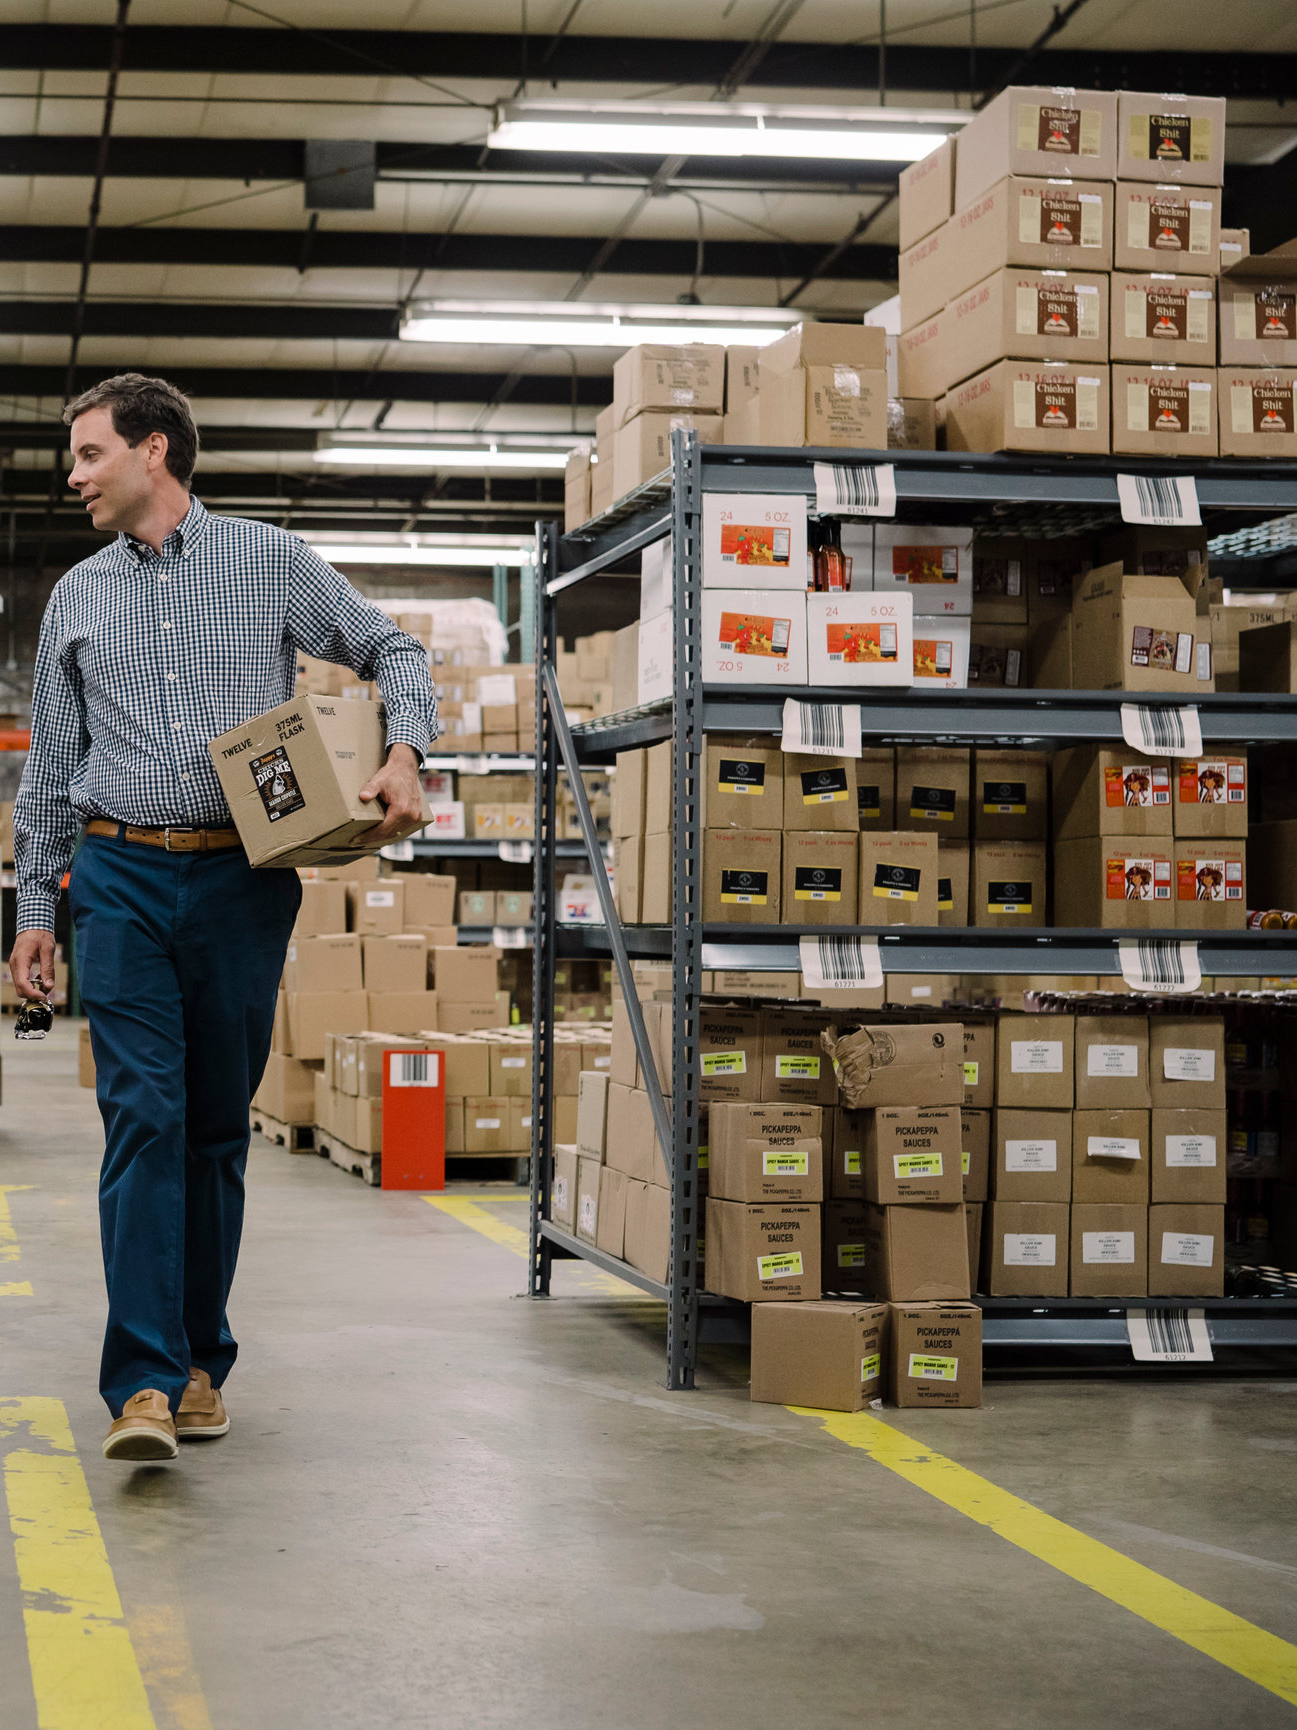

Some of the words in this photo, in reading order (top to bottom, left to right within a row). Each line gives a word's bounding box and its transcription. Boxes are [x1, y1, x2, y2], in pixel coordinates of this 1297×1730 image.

[1151, 117, 1190, 127] Chicken
[1159, 128, 1180, 139] Shit
[1042, 200, 1080, 211] Chicken
[1151, 206, 1189, 217] Chicken
[1050, 212, 1071, 223] Shit
[1159, 218, 1180, 229] Shit
[1039, 291, 1077, 302] Chicken
[1148, 294, 1186, 306] Chicken
[1047, 303, 1068, 314] Shit
[1156, 306, 1177, 317] Shit
[1036, 383, 1074, 394] Chicken
[1150, 387, 1188, 398] Chicken
[1254, 388, 1292, 398] Chicken
[1045, 395, 1066, 406] Shit
[1158, 399, 1179, 410] Shit
[1262, 400, 1283, 411] Shit
[720, 511, 733, 521] 24
[765, 512, 771, 521] 5
[825, 606, 839, 617] 24
[871, 606, 877, 616] 5
[736, 661, 743, 671] 5
[776, 662, 790, 672] 24
[316, 706, 336, 716] TWELVE
[275, 712, 304, 733] 375ML
[278, 723, 306, 743] FLASK
[221, 737, 254, 760] TWELVE
[255, 769, 274, 787] DIG
[274, 760, 292, 774] ME
[761, 1125, 802, 1134] PICKAPEPPA
[895, 1126, 939, 1136] PICKAPEPPA
[768, 1137, 795, 1146] SAUCES
[903, 1138, 931, 1148] SAUCES
[760, 1221, 801, 1231] PICKAPEPPA
[767, 1233, 794, 1243] SAUCES
[916, 1326, 961, 1337] PICKAPEPPA
[924, 1339, 952, 1349] SAUCES
